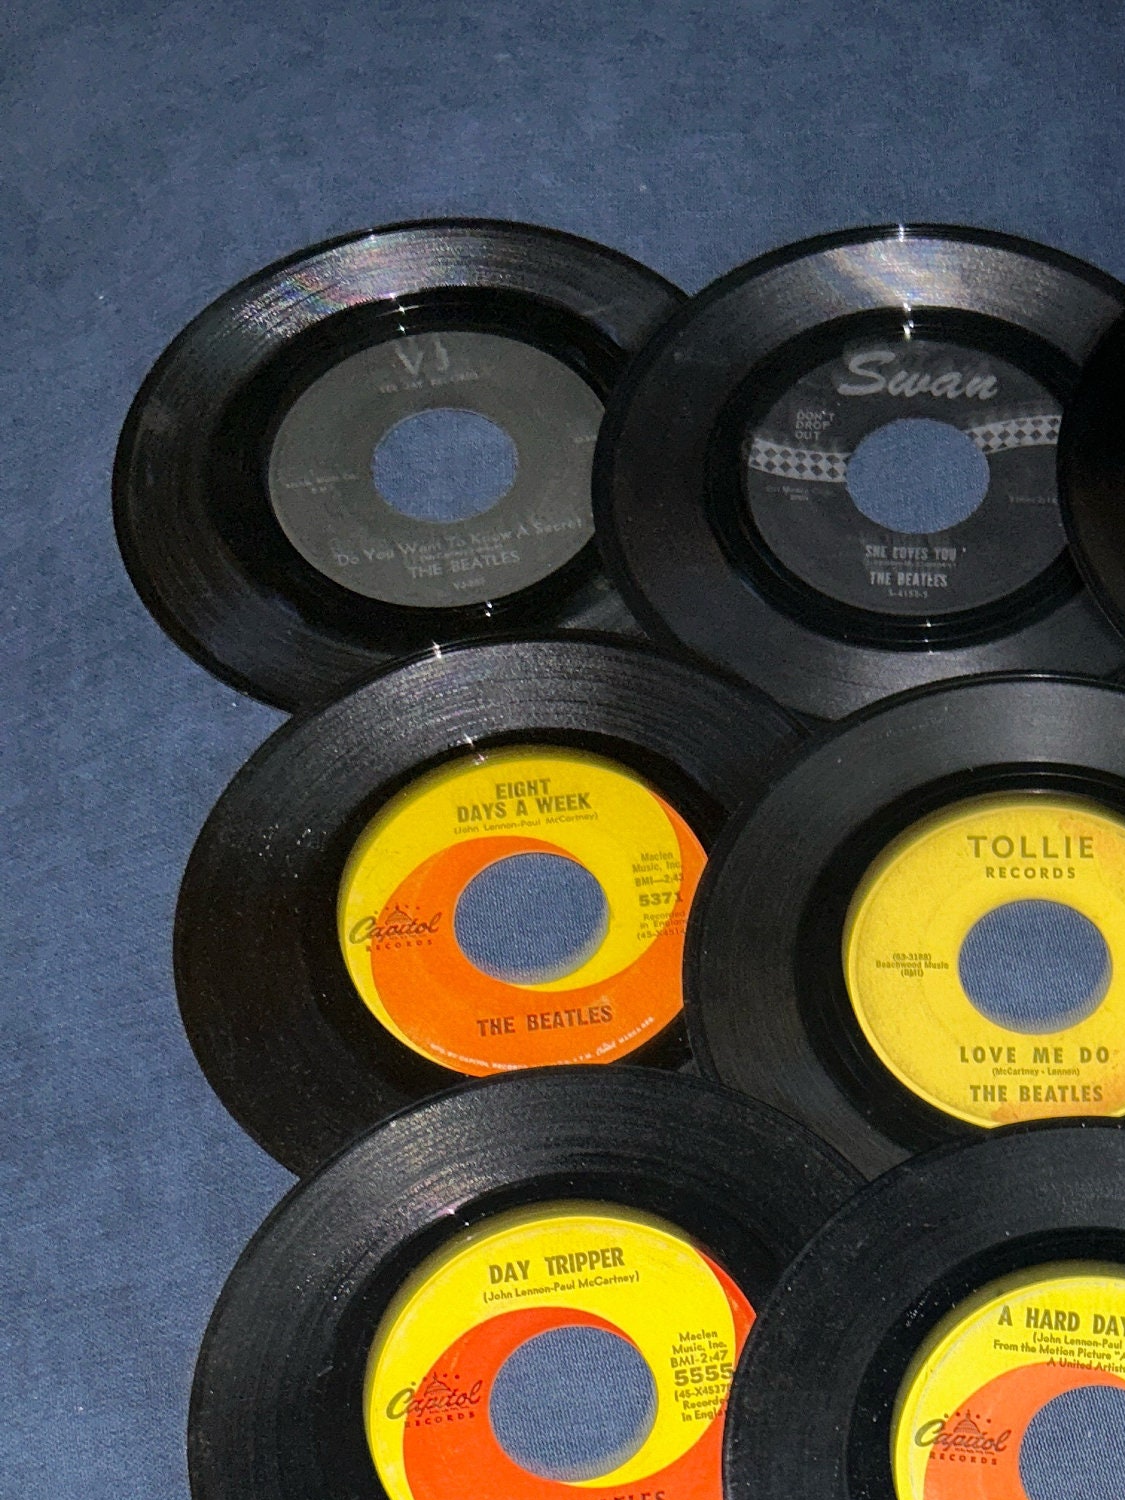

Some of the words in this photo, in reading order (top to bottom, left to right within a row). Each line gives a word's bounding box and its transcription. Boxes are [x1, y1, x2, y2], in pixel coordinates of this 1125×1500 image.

[837, 350, 999, 400] Swan
[796, 420, 832, 431] DROP
[795, 431, 821, 440] OUT
[337, 554, 359, 567] Do
[363, 547, 395, 562] You
[396, 541, 441, 556] Want
[446, 535, 466, 548] To
[515, 525, 530, 540] A
[532, 517, 583, 535] Secret
[865, 545, 888, 558] SHE
[934, 547, 957, 562] YOU
[408, 564, 443, 579] THE
[451, 551, 521, 574] BEATLES
[870, 571, 892, 586] THE
[897, 572, 949, 588] BEATLES
[495, 778, 552, 801] EIGHT
[457, 800, 507, 823] DAYS
[515, 799, 529, 817] A
[535, 792, 593, 815] WEEK
[641, 851, 674, 862] Maclen
[966, 835, 1095, 859] TOLLIE
[985, 866, 1077, 880] RECORDS
[639, 891, 684, 907] 5371
[349, 912, 442, 945] Capitol
[366, 939, 432, 952] RECORDS
[477, 1015, 516, 1037] THE
[527, 1005, 614, 1031] BEATLES
[959, 1046, 1017, 1063] LOVE
[1033, 1046, 1064, 1064] ME
[1079, 1046, 1111, 1064] DO
[970, 1085, 1008, 1102] THE
[1019, 1085, 1104, 1103] BEATLES
[488, 1260, 530, 1284] DAY
[544, 1247, 625, 1276] TRIPPER
[483, 1290, 513, 1303] (John
[515, 1280, 576, 1297] Lennon-Paul
[579, 1271, 641, 1289] McCartney)
[997, 1304, 1013, 1326] A
[1025, 1307, 1081, 1332] HARD
[679, 1329, 718, 1342] Maclen
[708, 1340, 727, 1350] Inc.
[1033, 1331, 1062, 1345] (John
[1064, 1334, 1124, 1350] Lennon-Paul
[993, 1339, 1019, 1351] From
[1021, 1341, 1037, 1353] the
[1039, 1344, 1075, 1358] Motion
[1077, 1347, 1112, 1360] Picture
[1047, 1358, 1057, 1367] A
[1059, 1359, 1093, 1371] United
[674, 1363, 734, 1386] 5555
[386, 1380, 483, 1420] Capitol
[405, 1411, 475, 1428] RECORDS
[914, 1418, 1012, 1452] Capitol
[929, 1451, 997, 1465] RECORDS
